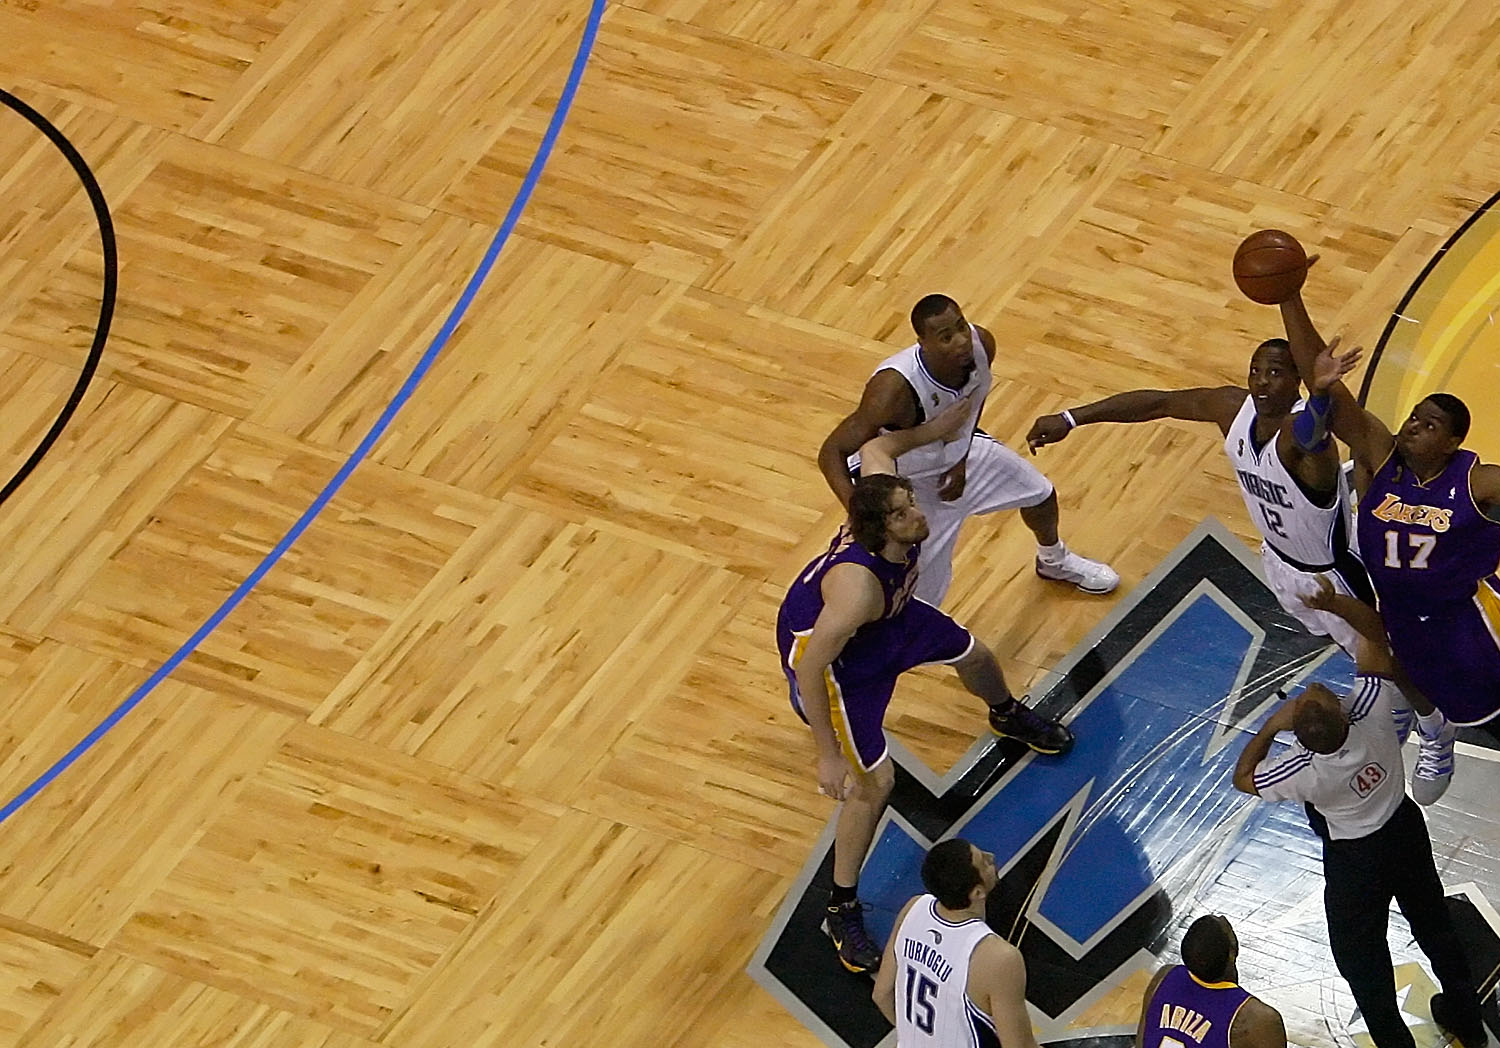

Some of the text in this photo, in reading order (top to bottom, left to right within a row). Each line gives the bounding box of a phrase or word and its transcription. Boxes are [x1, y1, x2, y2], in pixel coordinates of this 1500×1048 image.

[1258, 502, 1290, 540] 12
[1371, 492, 1454, 534] LAKERS
[1384, 529, 1437, 570] 17
[1356, 765, 1382, 794] 43
[902, 937, 954, 984] TURKOGLU
[905, 963, 940, 1038] 15
[1158, 1003, 1213, 1045] ARIZA
